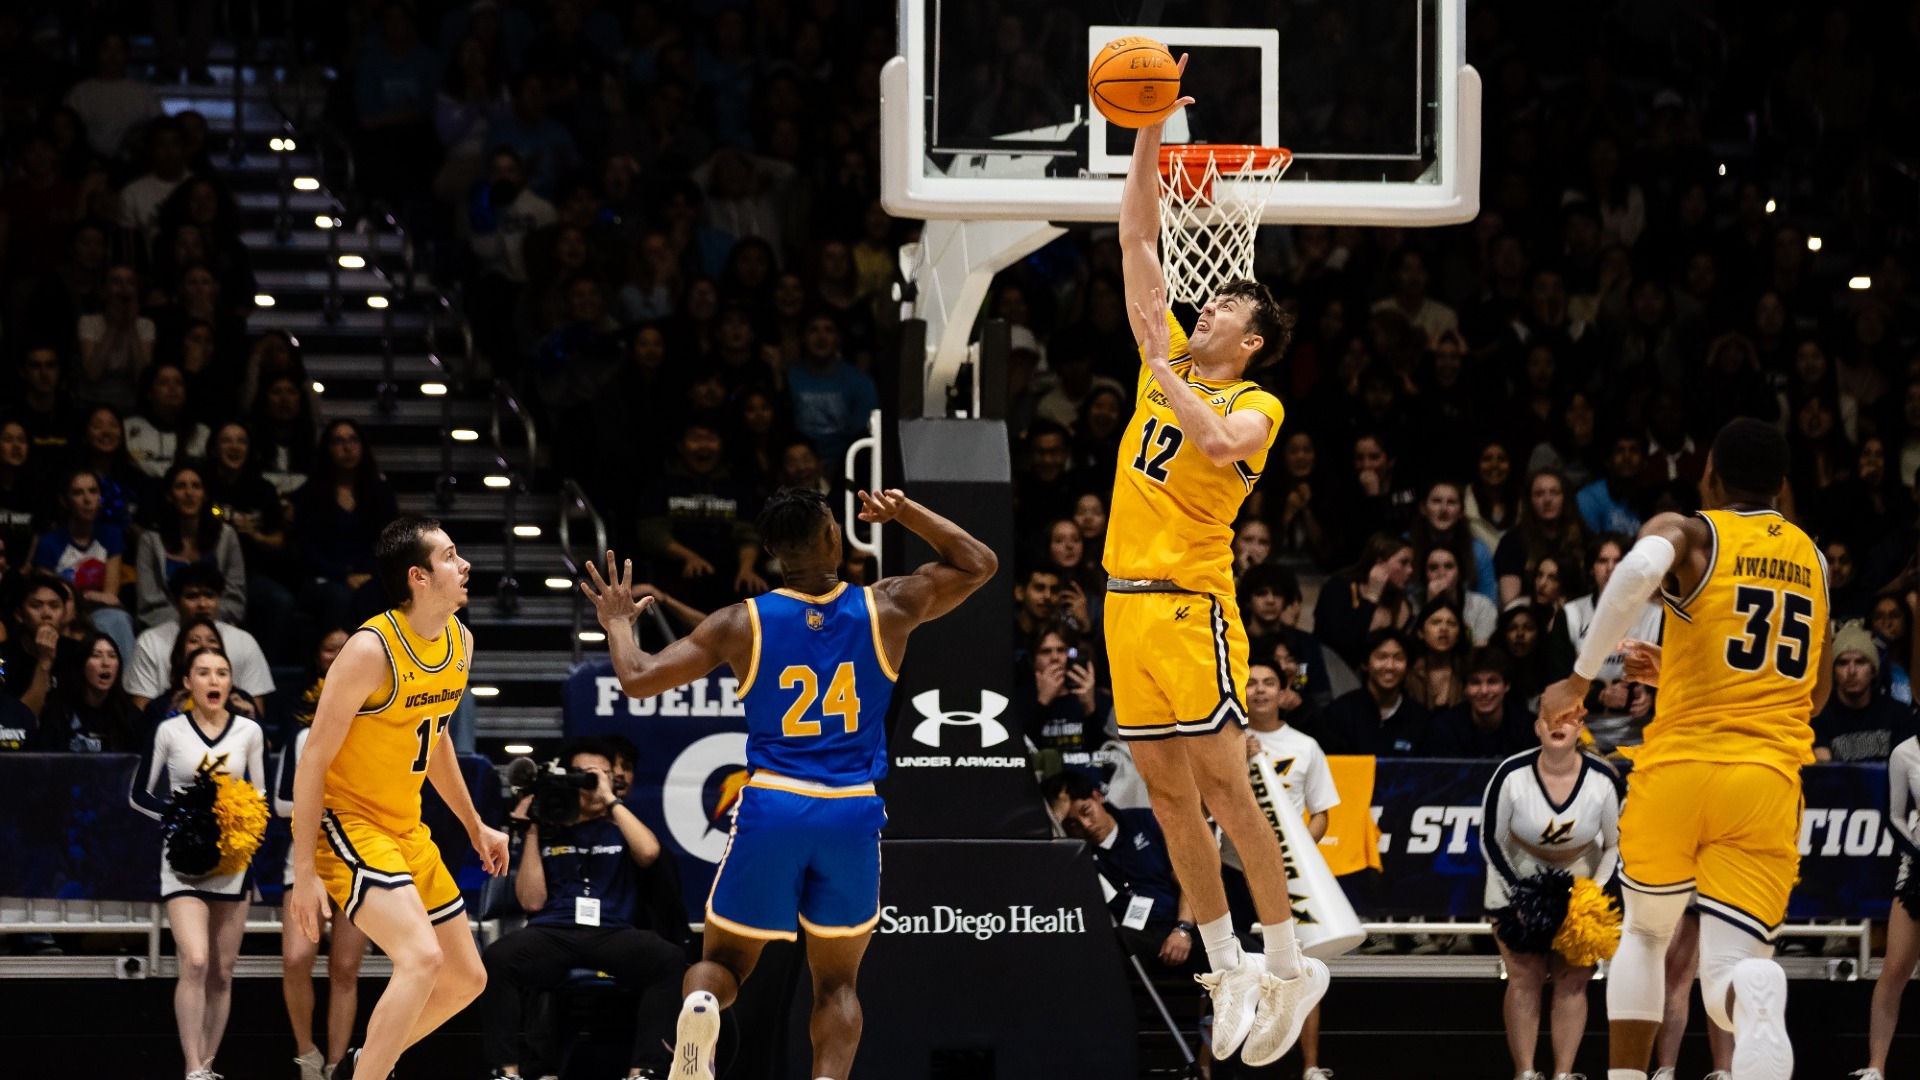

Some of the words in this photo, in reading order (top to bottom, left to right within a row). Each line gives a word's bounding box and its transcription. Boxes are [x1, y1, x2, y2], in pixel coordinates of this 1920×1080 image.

[1132, 416, 1184, 483] 12
[1733, 555, 1812, 589] NWAOKORIE
[1724, 584, 1814, 682] 35
[778, 661, 862, 738] 24
[895, 756, 951, 768] UNDER
[954, 756, 1026, 768] ARMOUR
[879, 905, 929, 934] San
[931, 905, 1006, 941] Diego
